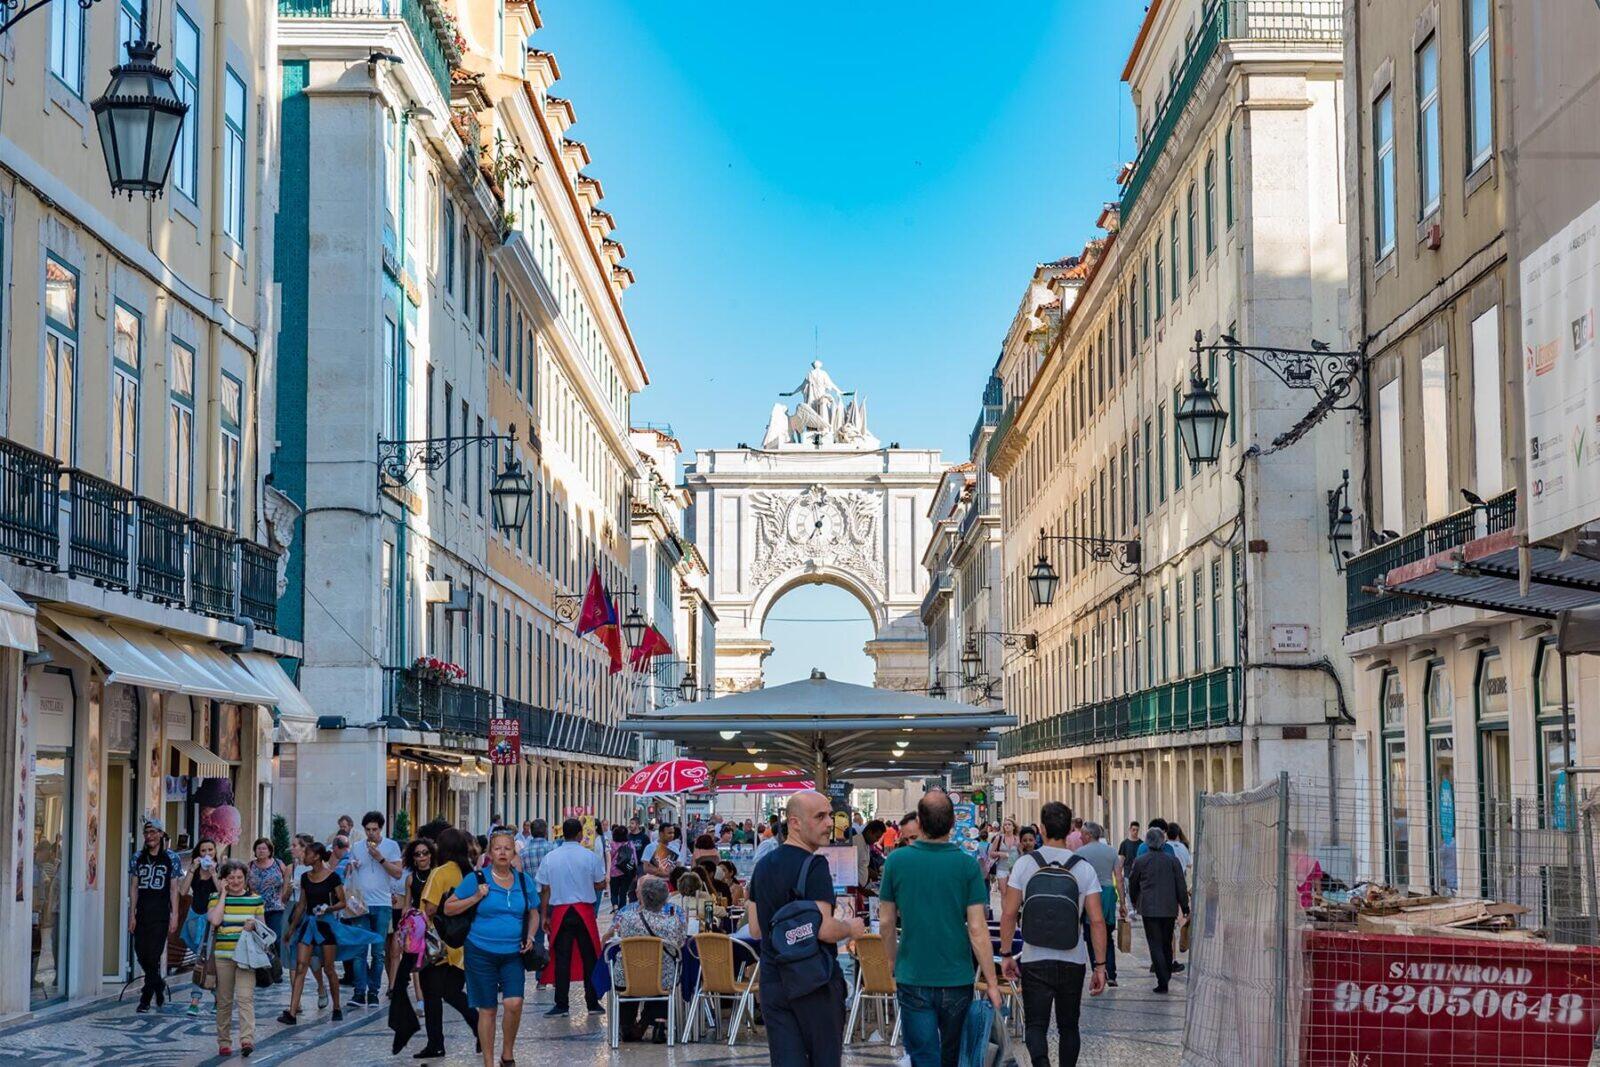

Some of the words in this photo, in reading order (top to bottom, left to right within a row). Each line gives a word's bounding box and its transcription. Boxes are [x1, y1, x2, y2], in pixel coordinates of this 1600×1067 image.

[138, 864, 167, 890] 26
[785, 922, 813, 945] SPORT
[1389, 961, 1533, 985] SATINROAD
[1334, 981, 1584, 1025] 962050648
